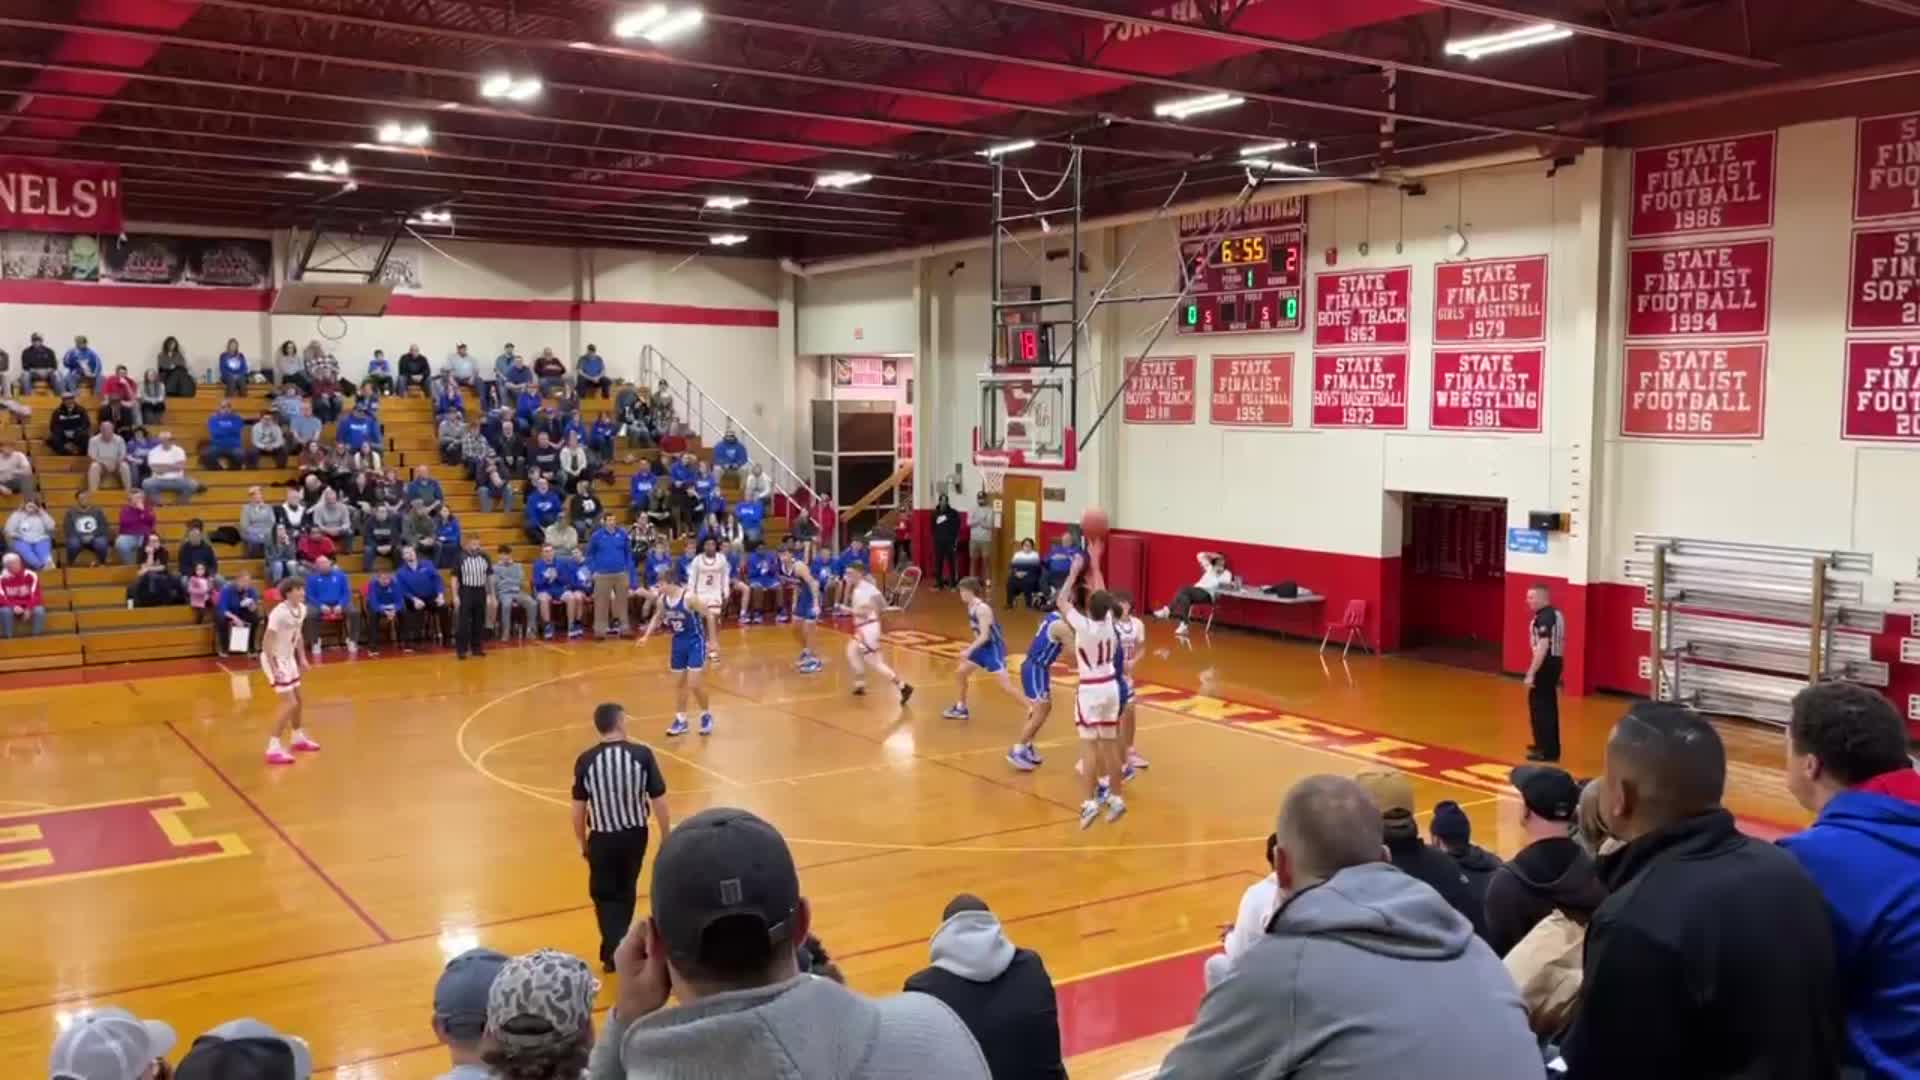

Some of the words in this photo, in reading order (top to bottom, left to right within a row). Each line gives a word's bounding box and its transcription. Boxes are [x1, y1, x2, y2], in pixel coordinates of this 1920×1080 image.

[1666, 142, 1737, 169] STATE
[1647, 160, 1757, 193] FINALIST
[1640, 181, 1761, 214] FOOTBALL
[1673, 206, 1723, 230] 1986
[1222, 236, 1264, 263] 6:55
[1286, 247, 1297, 271] 2
[1663, 248, 1733, 271] STATE
[1338, 275, 1386, 293] STATE
[1461, 263, 1517, 286] STATE
[1644, 268, 1752, 293] FINALIST
[1326, 291, 1398, 311] FINALIST
[1446, 283, 1533, 305] FINALIST
[1637, 289, 1757, 313] FOOTBALL
[1187, 304, 1198, 327] 0
[1286, 297, 1297, 319] 0
[1318, 310, 1351, 326] BOYS
[1359, 307, 1406, 324] TRACK
[1466, 319, 1505, 339] 1979
[1669, 312, 1719, 333] 1994
[1020, 332, 1036, 360] 18
[1140, 361, 1177, 376] STATE
[1231, 360, 1272, 376] STATE
[1335, 357, 1383, 373] STATE
[1458, 354, 1514, 372] STATE
[1657, 351, 1729, 371] STATE
[1130, 376, 1185, 391] FINALIST
[1218, 376, 1281, 393] FINALIST
[1323, 374, 1397, 390] FINALIST
[1444, 372, 1529, 391] FINALIST
[1639, 370, 1748, 391] FINALIST
[1436, 391, 1537, 409] WRESTLING
[1632, 391, 1751, 413] FOOTBALL
[1342, 407, 1375, 424] 1973
[1466, 408, 1501, 427] 1981
[1097, 638, 1112, 665] 11
